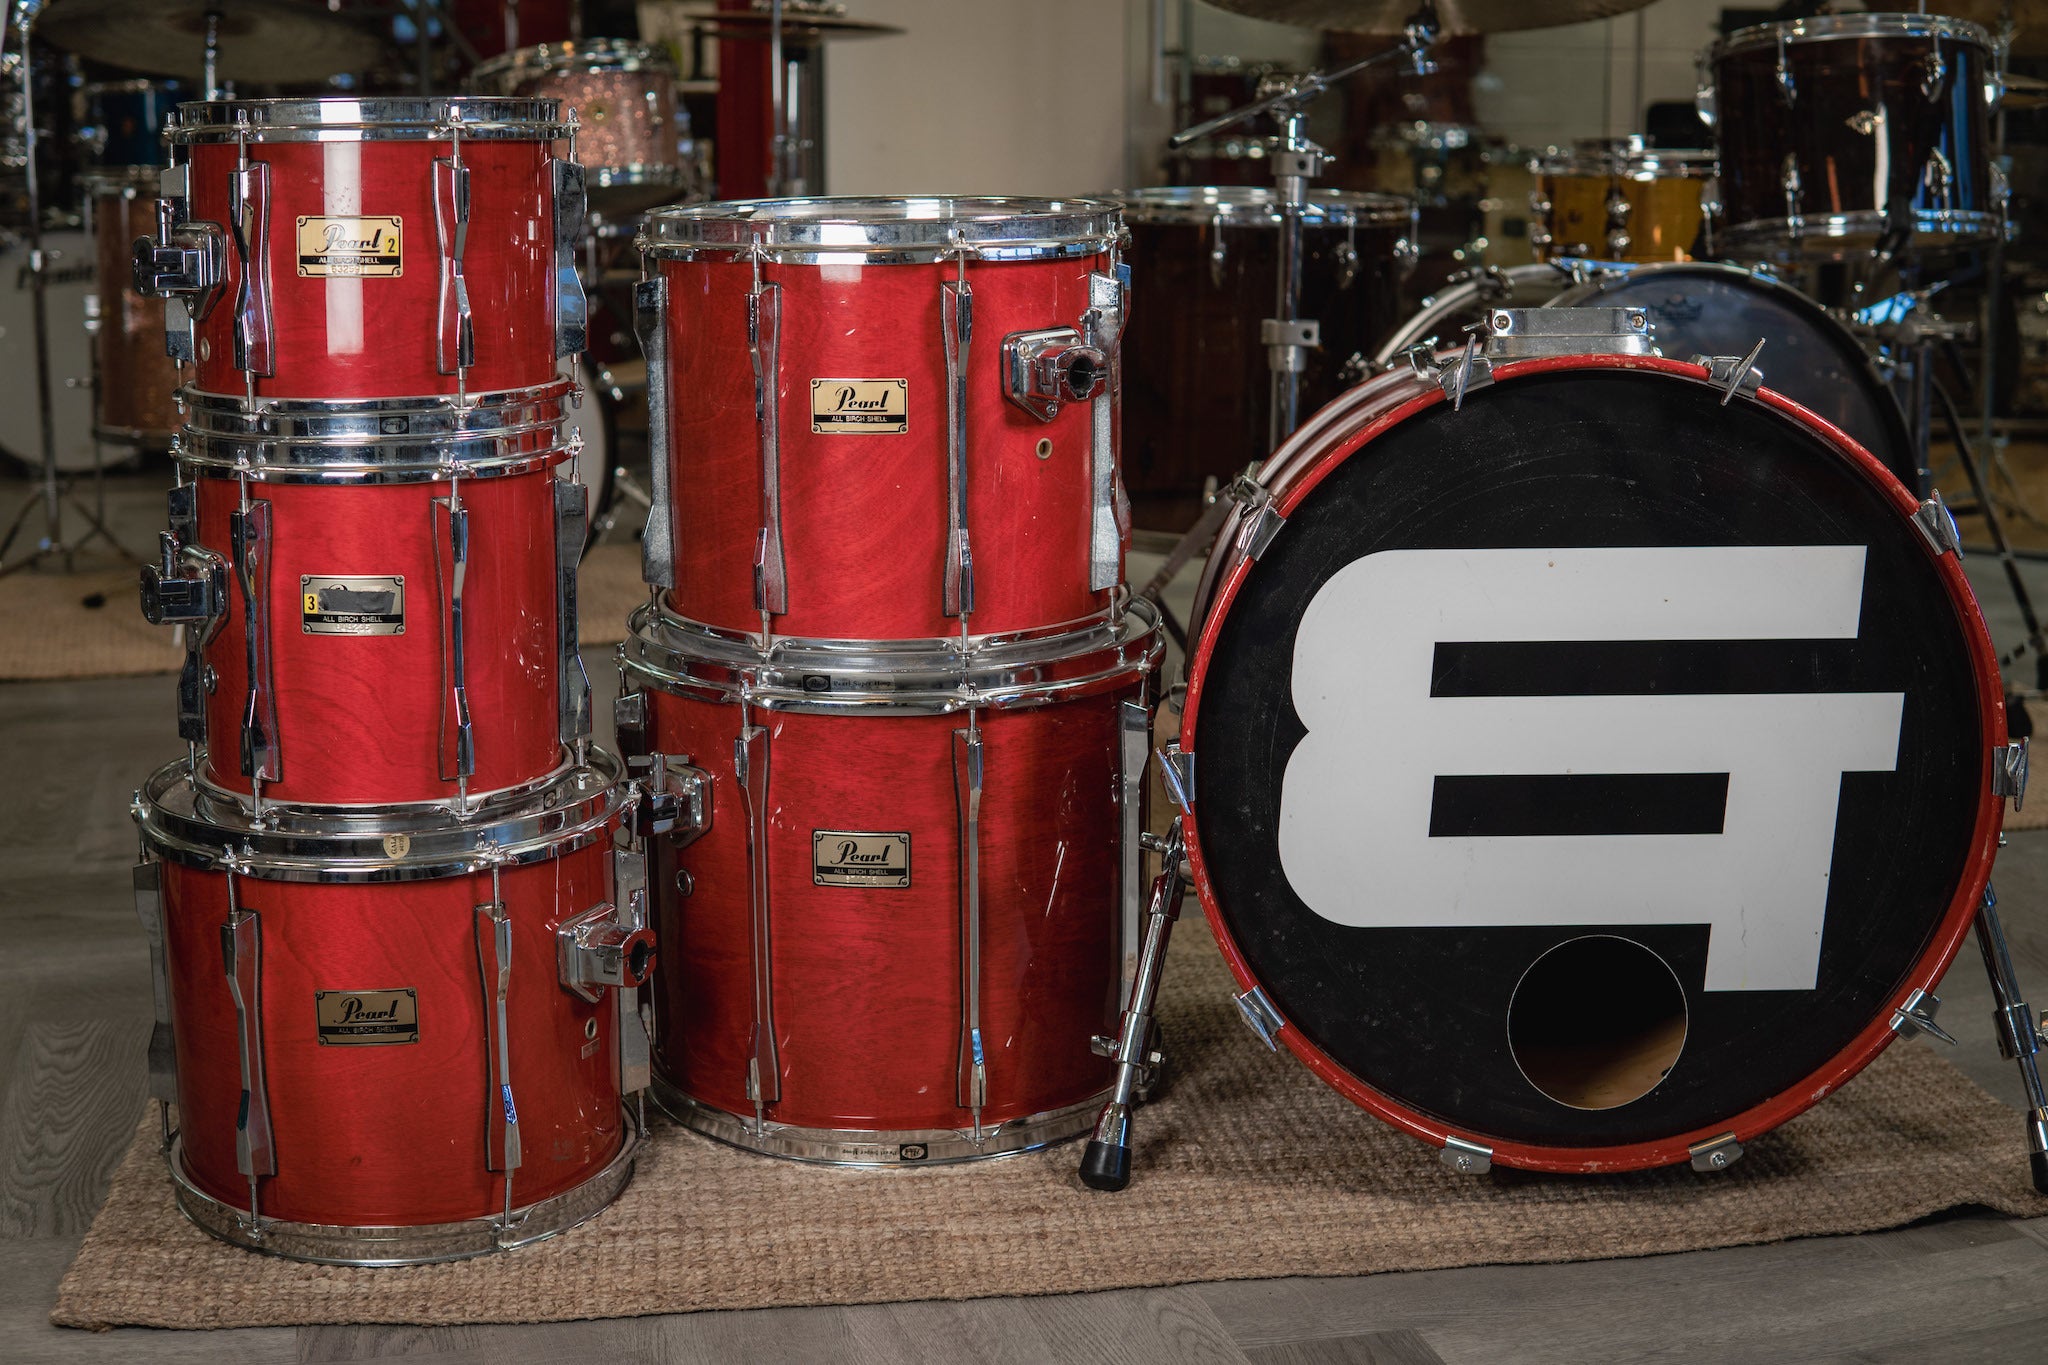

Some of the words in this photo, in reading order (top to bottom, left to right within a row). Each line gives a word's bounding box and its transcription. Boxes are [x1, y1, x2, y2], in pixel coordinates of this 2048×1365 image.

[314, 223, 382, 253] Pearl
[387, 237, 395, 253] 2
[825, 385, 889, 412] Pearl
[308, 595, 315, 611] 3
[830, 840, 891, 864] Pearl
[333, 997, 398, 1024] Pearl
